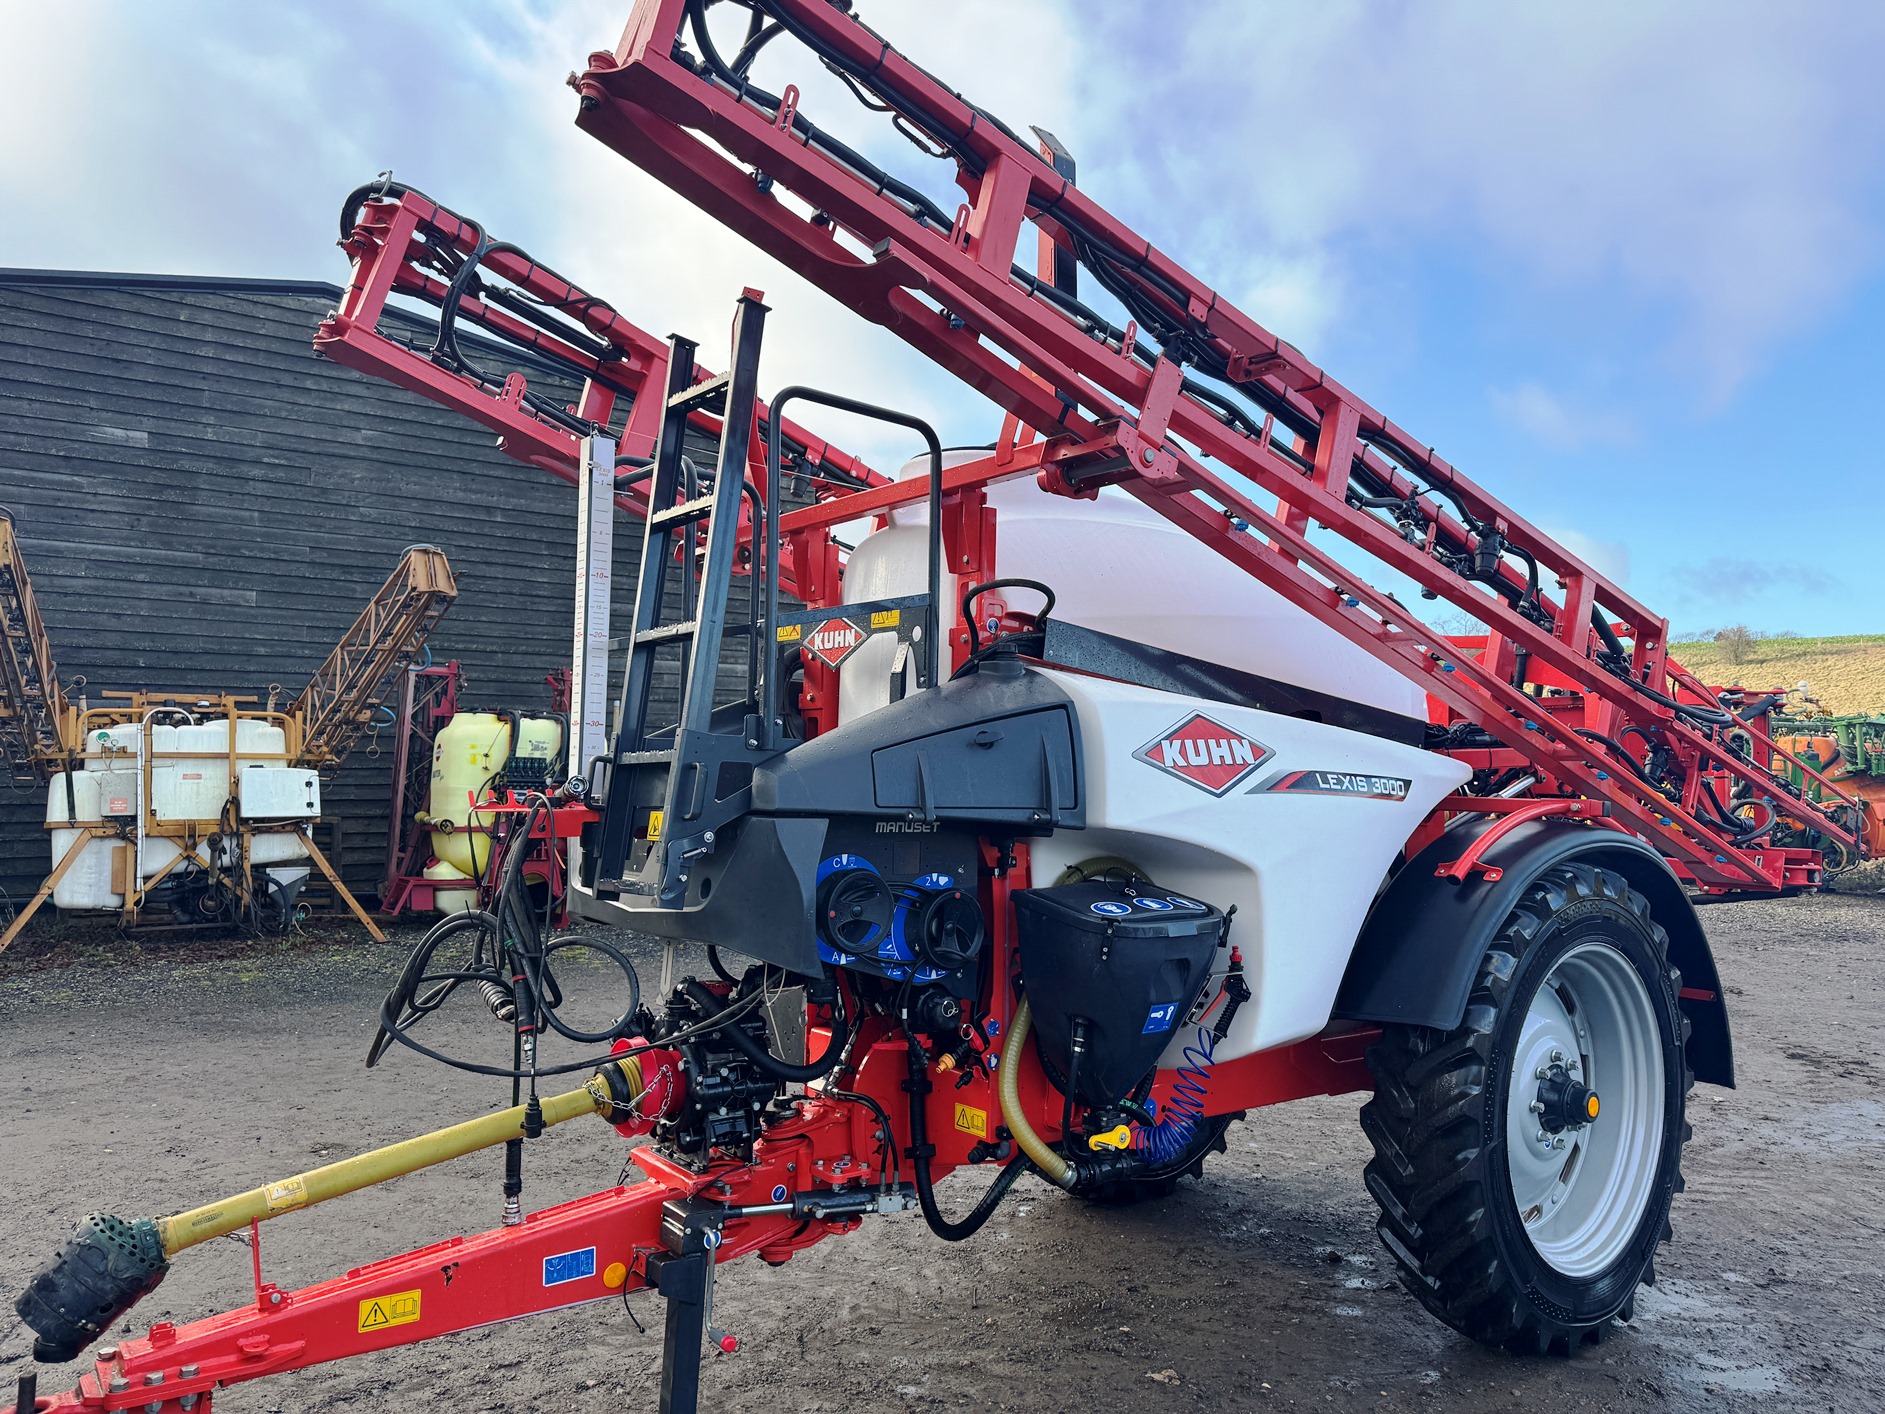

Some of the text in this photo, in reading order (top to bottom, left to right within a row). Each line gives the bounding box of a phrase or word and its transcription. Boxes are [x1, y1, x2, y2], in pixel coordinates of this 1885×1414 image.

[814, 628, 856, 651] KUHN
[1160, 738, 1256, 768] KUHN
[1314, 772, 1405, 796] LEXIS 3000
[875, 821, 940, 834] MANUSET
[833, 857, 841, 868] C
[925, 876, 931, 886] 2
[831, 952, 839, 962] A
